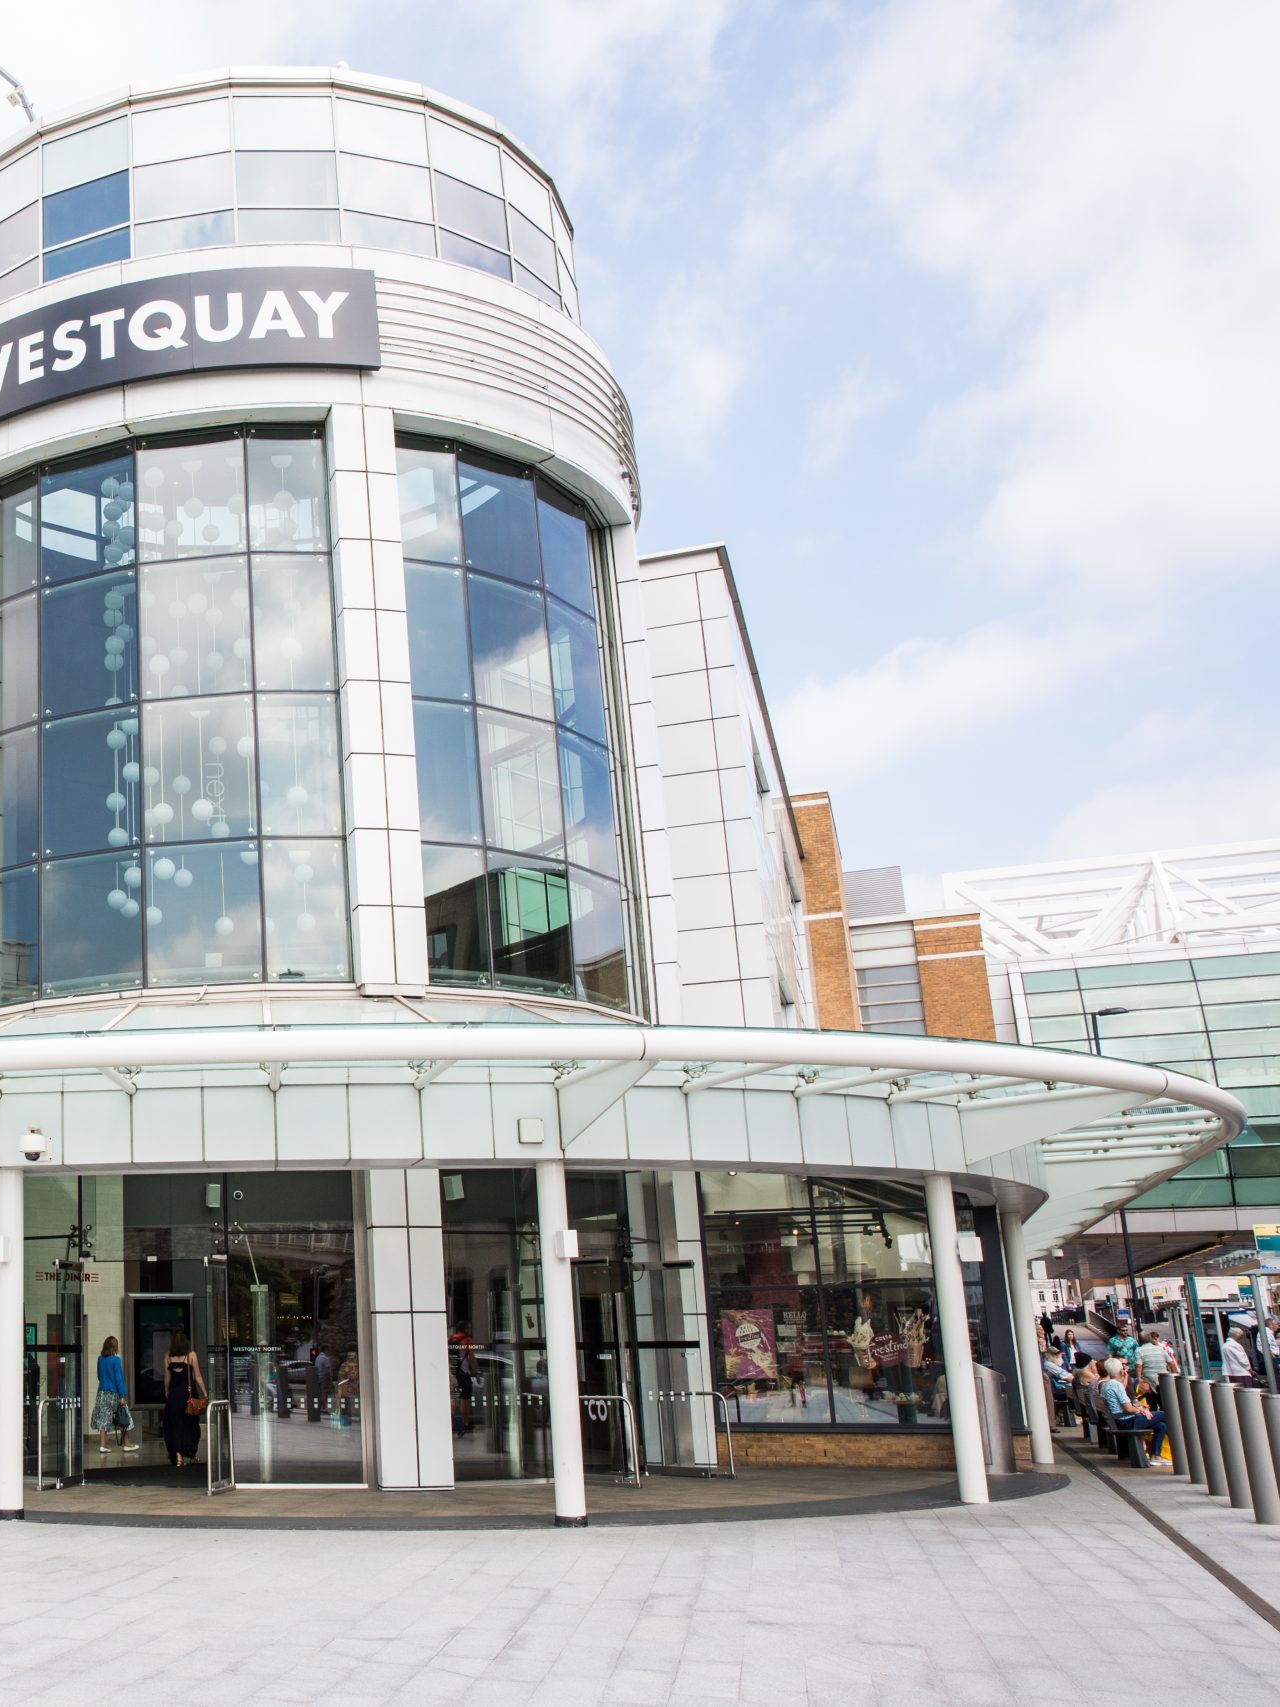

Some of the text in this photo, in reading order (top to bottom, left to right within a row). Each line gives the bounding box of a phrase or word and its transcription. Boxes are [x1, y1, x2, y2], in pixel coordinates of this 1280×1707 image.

[205, 763, 226, 827] next
[44, 1272, 61, 1281] THE
[783, 1311, 807, 1319] HELLO
